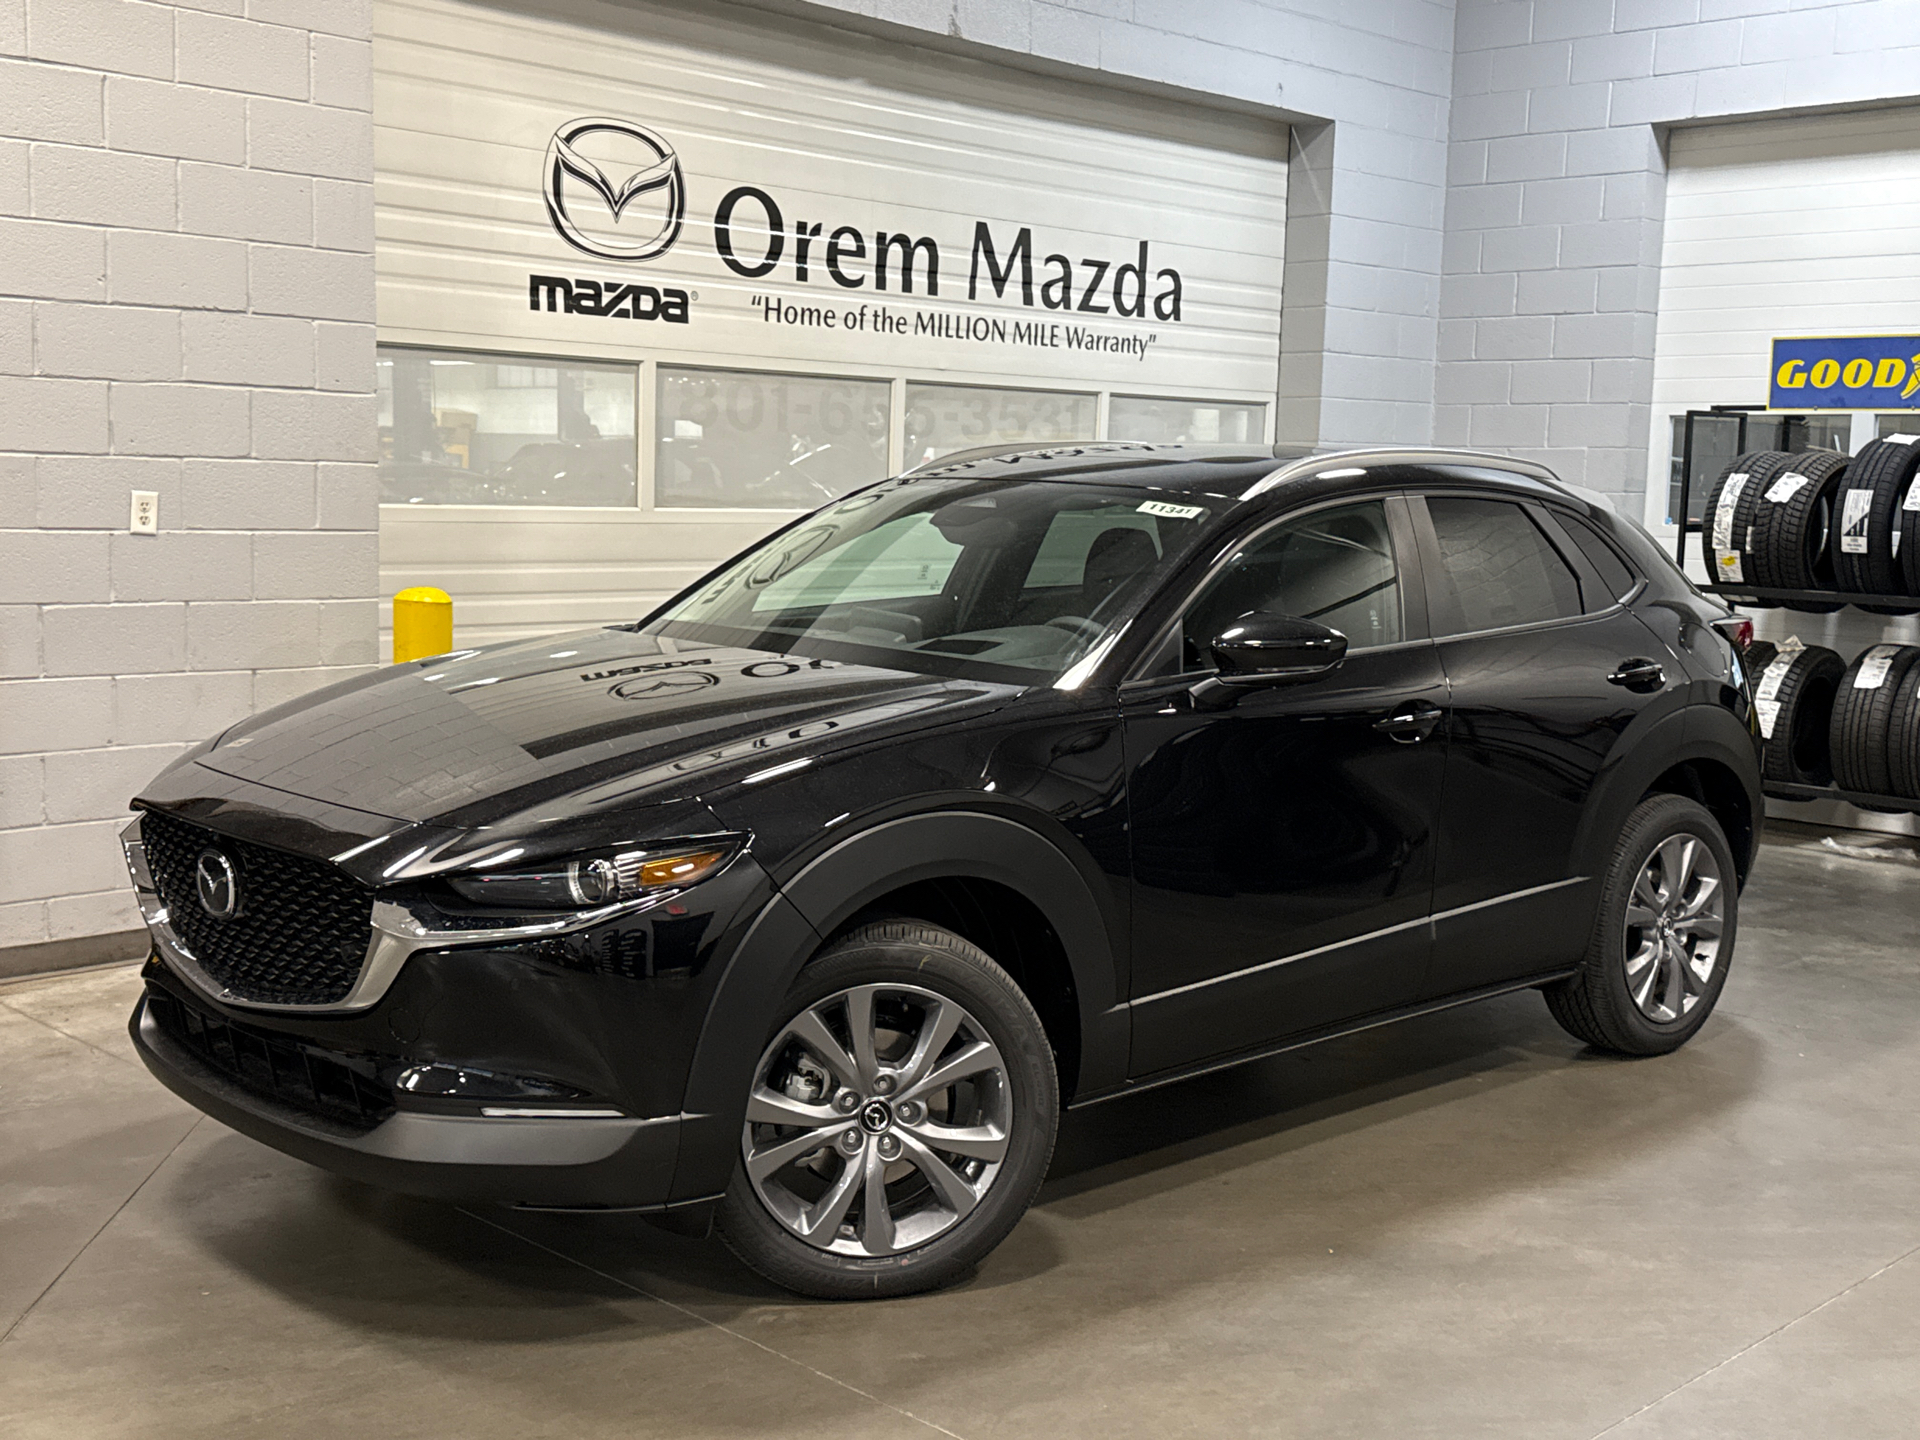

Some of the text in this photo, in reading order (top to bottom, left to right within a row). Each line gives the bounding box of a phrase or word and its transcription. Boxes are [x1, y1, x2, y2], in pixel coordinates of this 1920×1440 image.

[714, 186, 1182, 322] Orem Mazda
[529, 274, 690, 324] mazda
[751, 295, 1157, 361] “Home of the MILLION MILE Warranty”
[1776, 358, 1906, 389] GOOD
